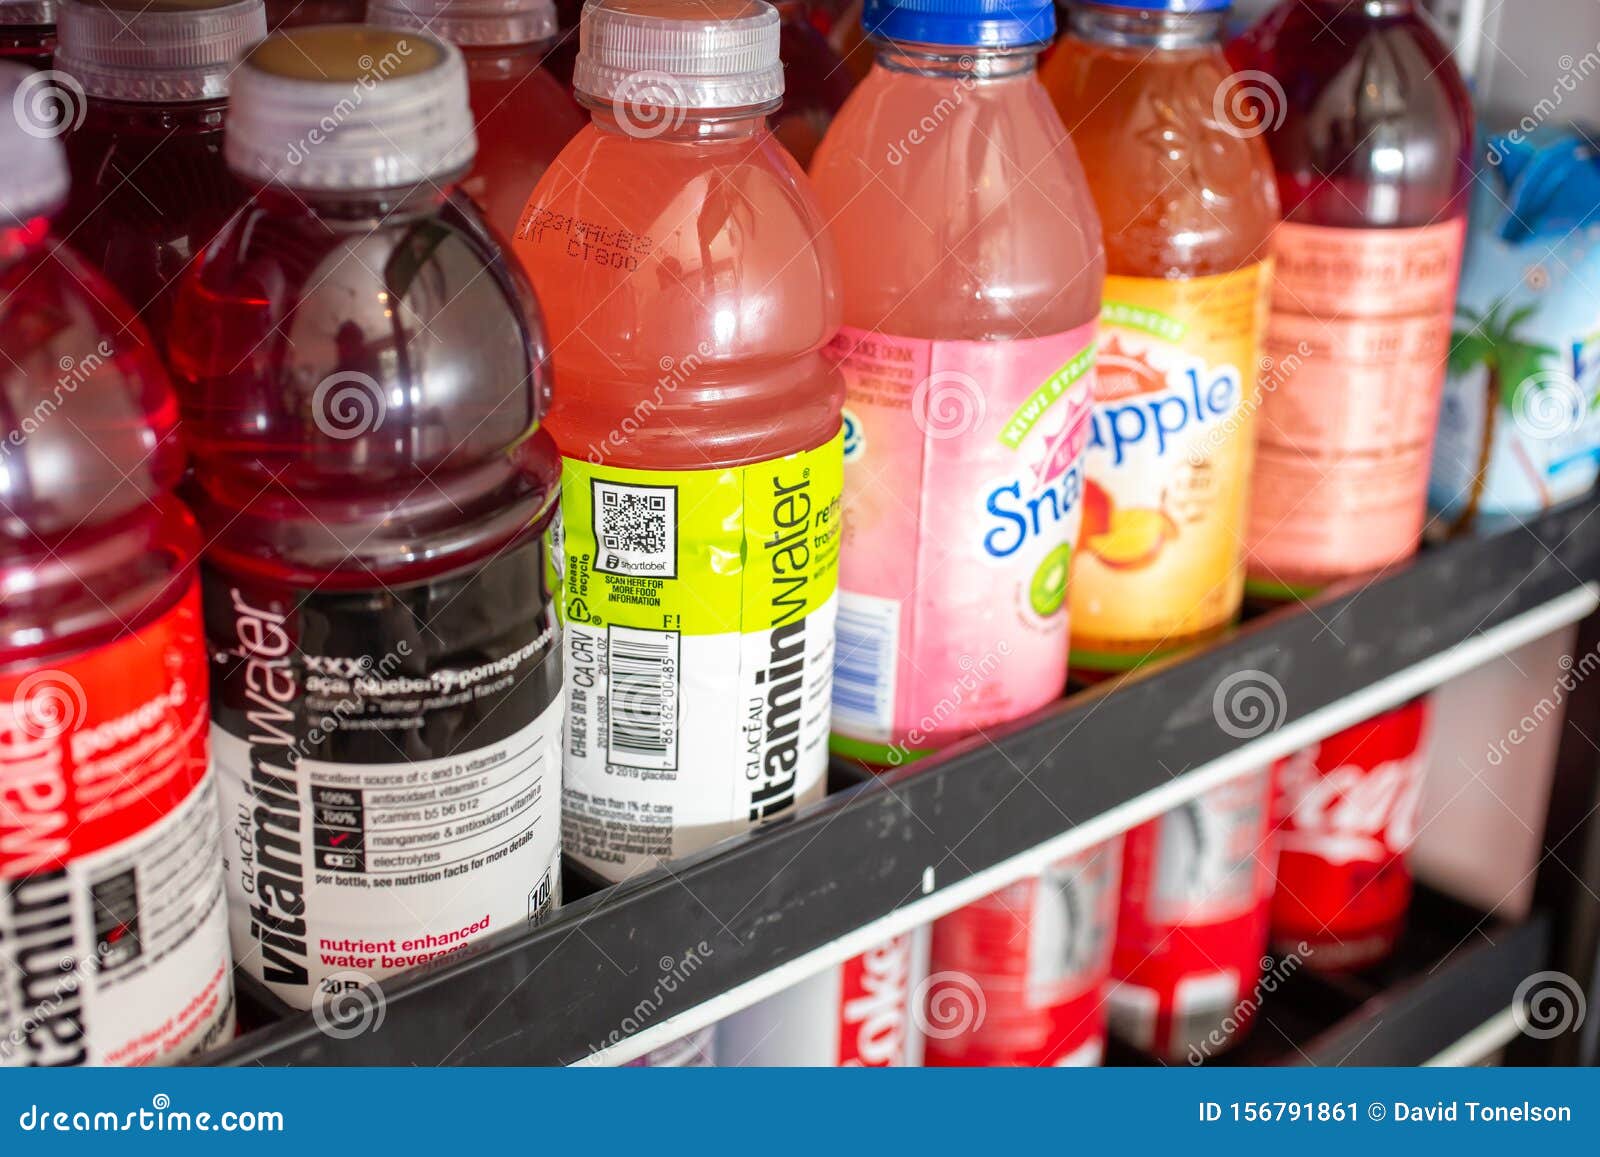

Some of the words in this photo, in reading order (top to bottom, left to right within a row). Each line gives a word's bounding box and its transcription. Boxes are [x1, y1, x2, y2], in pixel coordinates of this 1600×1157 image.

[984, 458, 1084, 558] Sna
[568, 556, 578, 594] please
[580, 554, 590, 596] recycle
[605, 575, 626, 585] SCAN
[627, 577, 647, 587] HERE
[648, 579, 664, 589] FOR
[612, 585, 634, 595] MORE
[608, 594, 661, 606] INFORMATION
[571, 631, 593, 663] CRV
[573, 667, 594, 688] CA
[662, 658, 674, 697] 00485
[743, 697, 764, 781] GLACÉAU
[310, 772, 361, 785] excellent
[364, 775, 404, 785] source
[407, 772, 419, 783] of
[431, 767, 452, 780] and
[455, 763, 462, 775] b
[466, 750, 507, 773] vitamins
[616, 766, 639, 778] 2019
[370, 788, 436, 804] antioxidant
[439, 779, 478, 797] vitamin
[323, 811, 356, 825] 100%
[372, 808, 421, 825] vitamins
[424, 806, 439, 820] b5
[441, 802, 456, 816] b6
[459, 798, 480, 812] b12
[372, 832, 441, 848] manganese
[456, 808, 509, 835] antioxidant
[316, 874, 333, 885] per
[335, 874, 371, 889] bottle,
[373, 877, 393, 887] see
[395, 870, 441, 886] nutrition
[443, 863, 469, 879] facts
[471, 856, 484, 871] for
[486, 847, 508, 865] more
[509, 829, 534, 855] details
[373, 851, 441, 868] electrolytes
[320, 938, 396, 953] nutrient
[401, 915, 490, 951] enhanced
[320, 953, 375, 968] water
